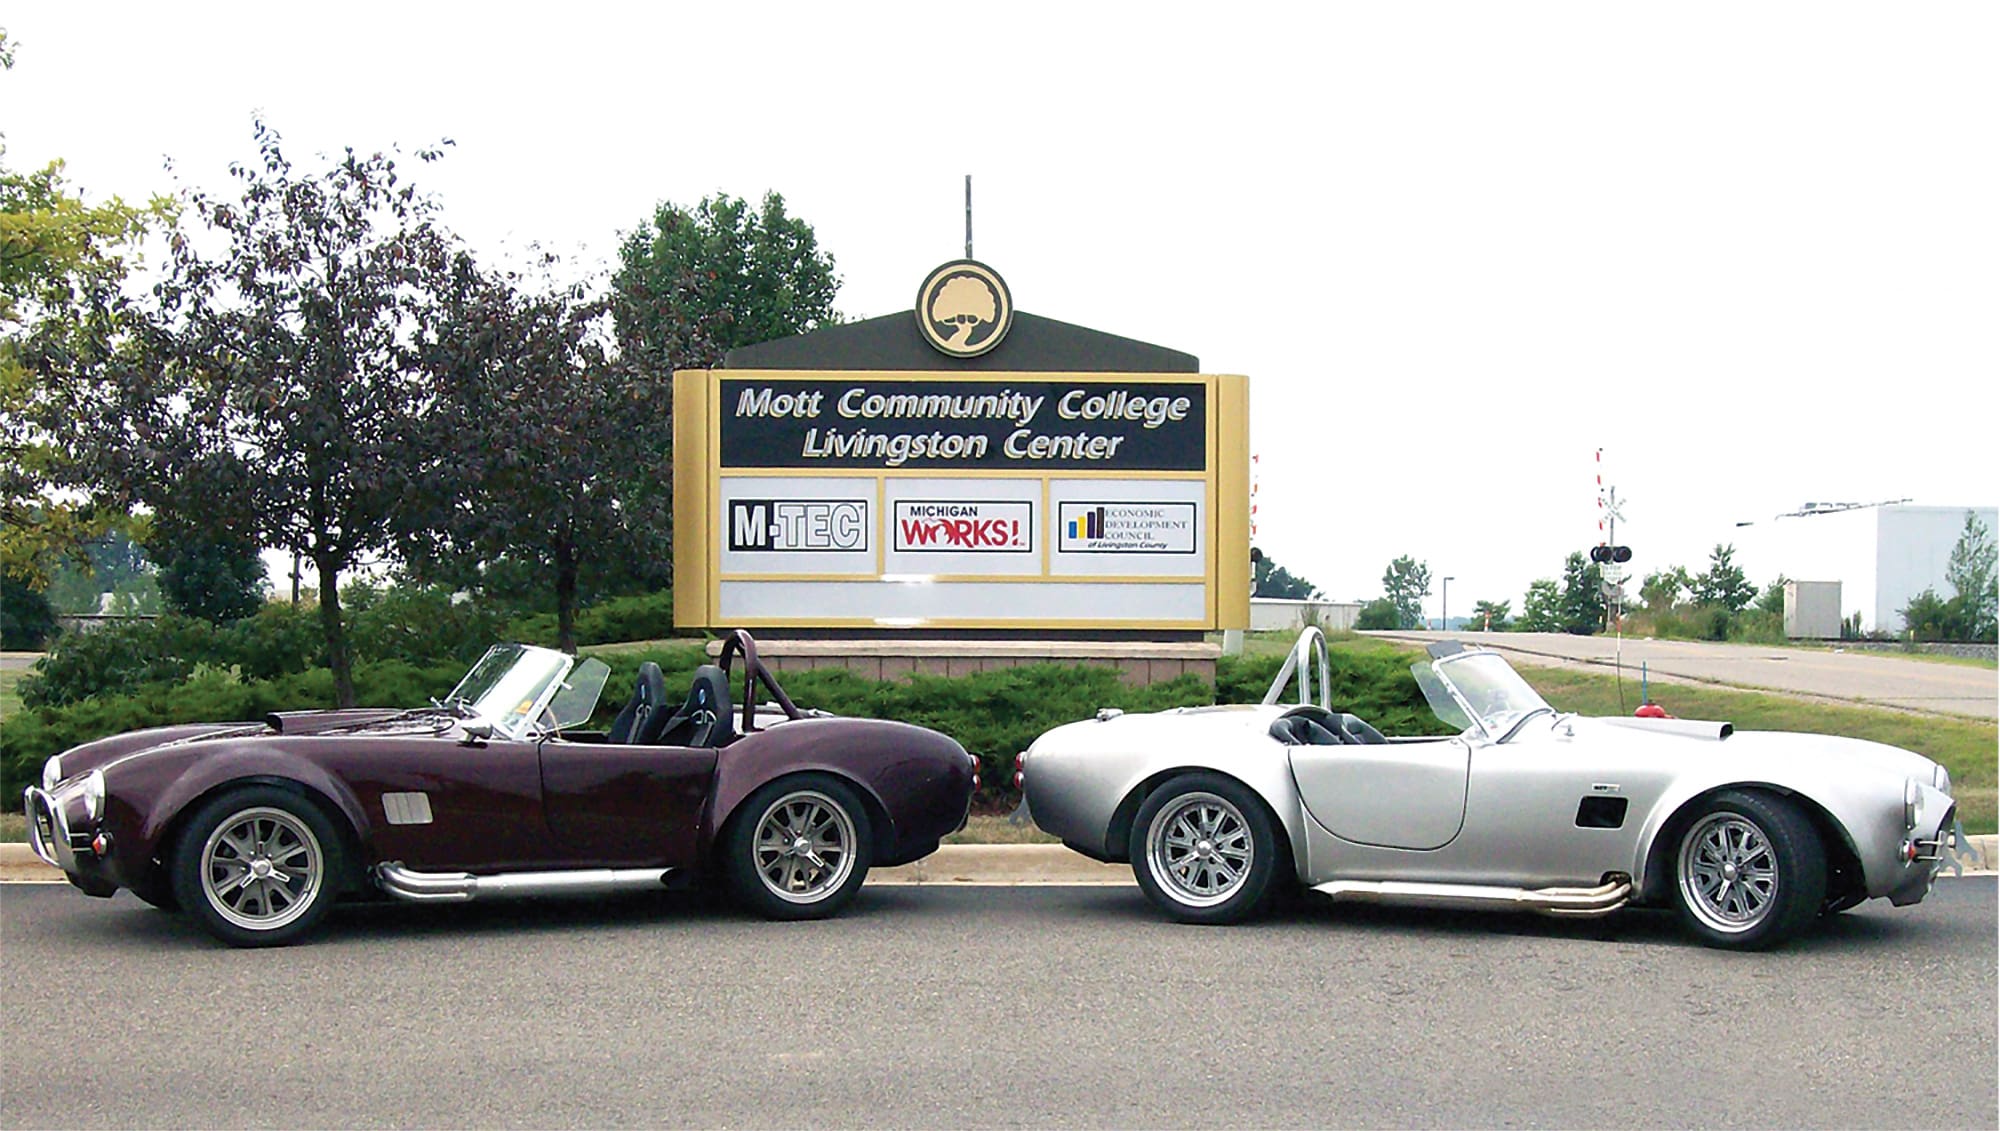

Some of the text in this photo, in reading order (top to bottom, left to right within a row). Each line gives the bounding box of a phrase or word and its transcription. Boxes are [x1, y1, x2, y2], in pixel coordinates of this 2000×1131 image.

[735, 388, 1191, 428] Mott Community College
[802, 428, 1124, 466] Livingston Center
[910, 506, 978, 517] MICHIGAN
[1105, 509, 1165, 518] ECONOMIC
[734, 504, 860, 548] M-TEC
[1105, 520, 1188, 529] DEVELOPMENT
[901, 519, 1019, 548] WORKS!
[1104, 531, 1154, 540] COUNCIL
[1098, 541, 1138, 549] Livingston
[1140, 541, 1168, 549] County
